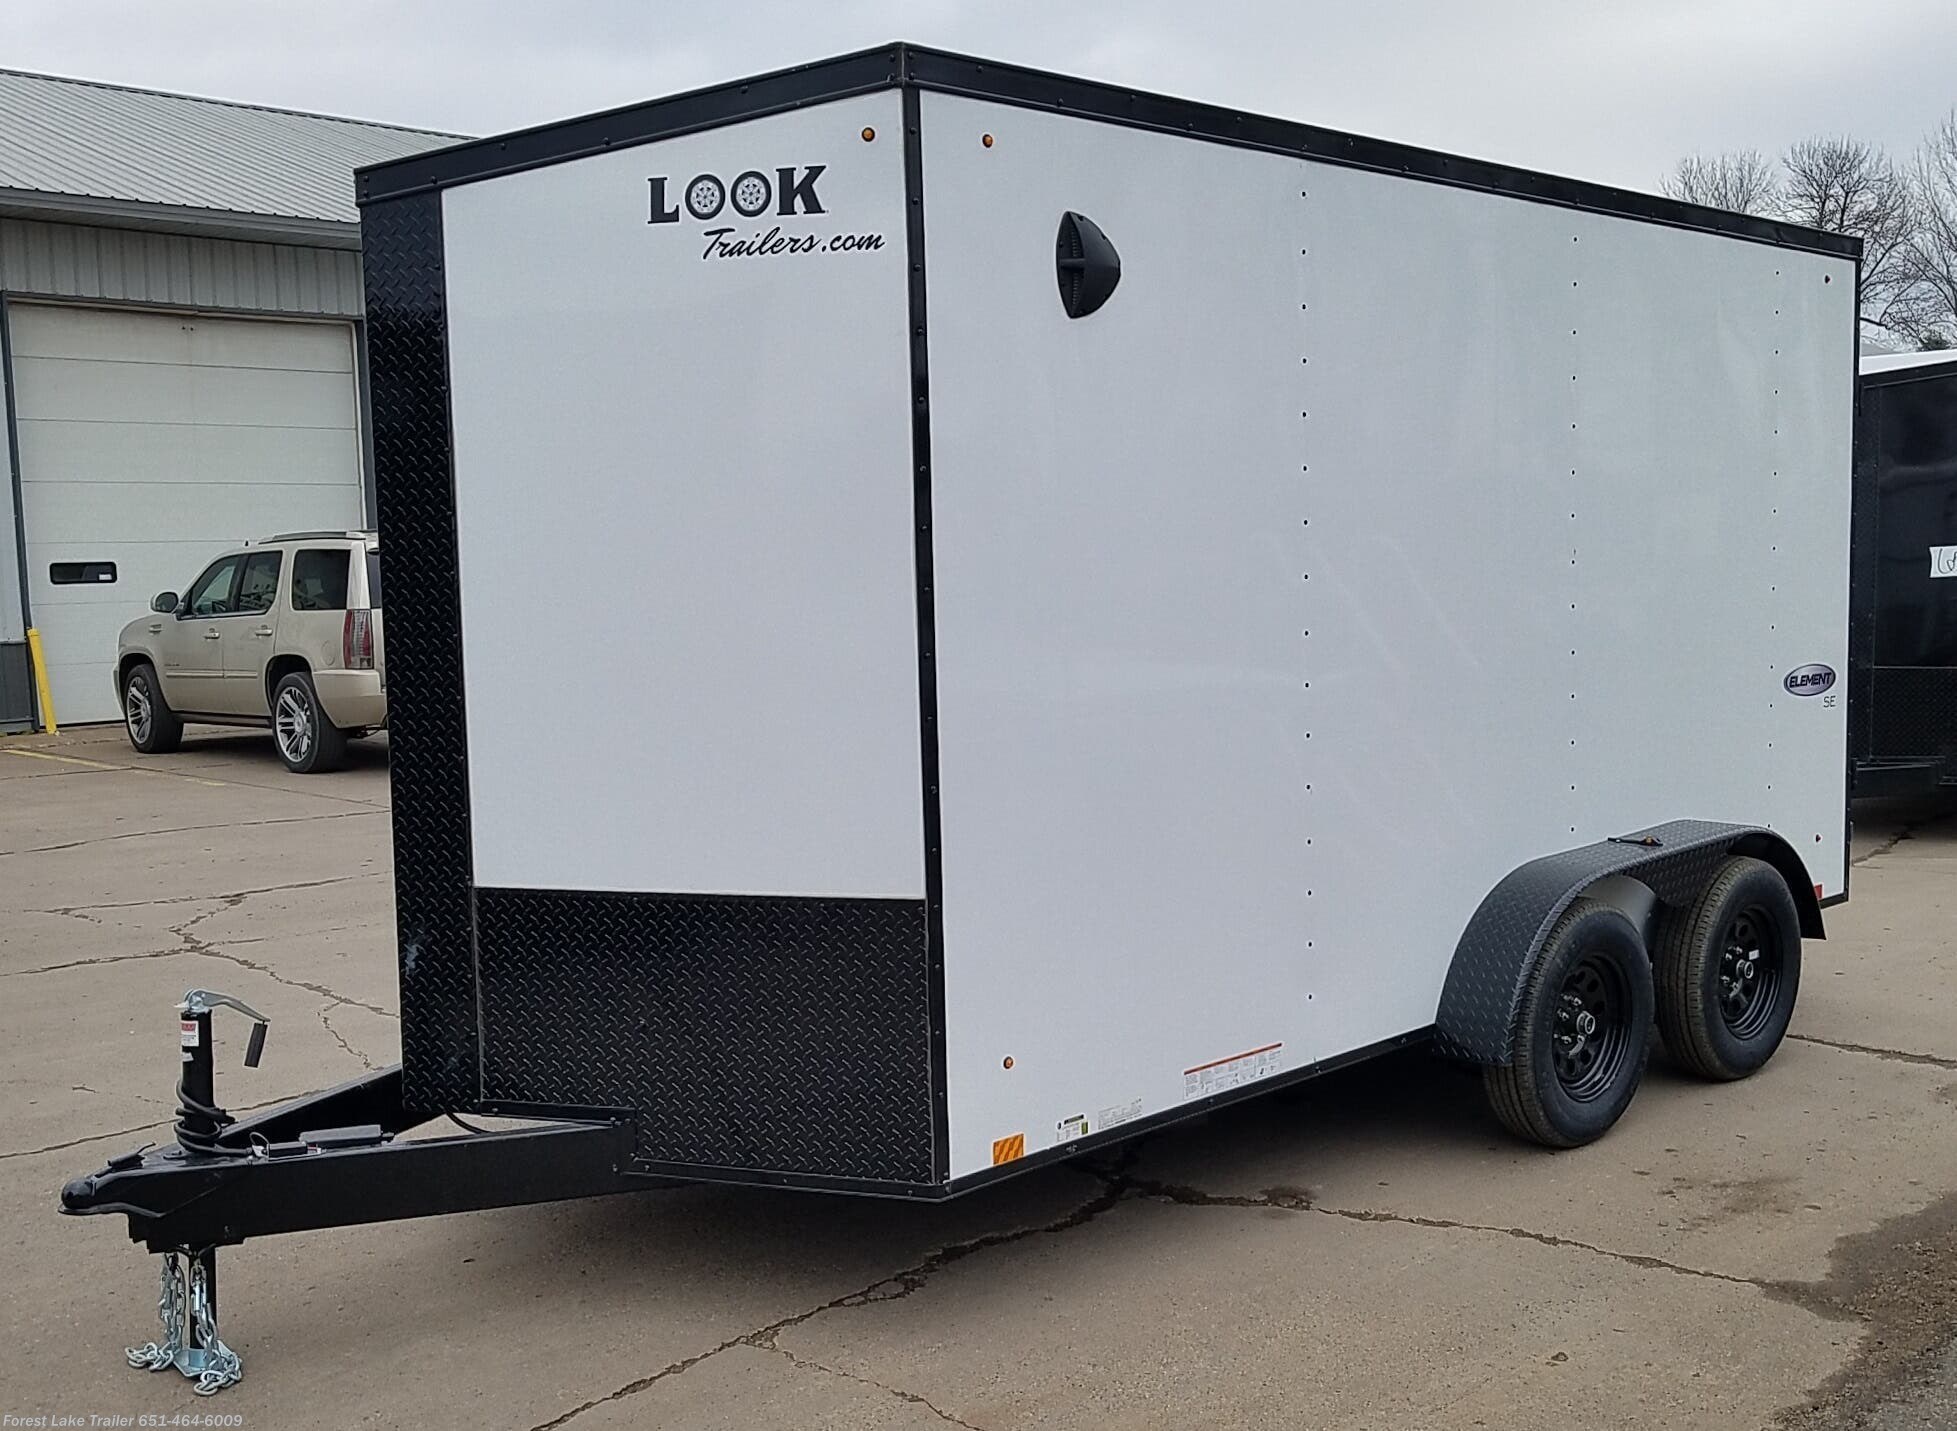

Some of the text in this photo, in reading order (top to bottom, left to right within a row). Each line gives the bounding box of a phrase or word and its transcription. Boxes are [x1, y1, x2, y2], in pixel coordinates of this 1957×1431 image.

[648, 165, 827, 224] LOOK
[703, 227, 885, 259] Trailers.com
[1789, 672, 1832, 688] ELEMENT
[1823, 695, 1836, 708] SE
